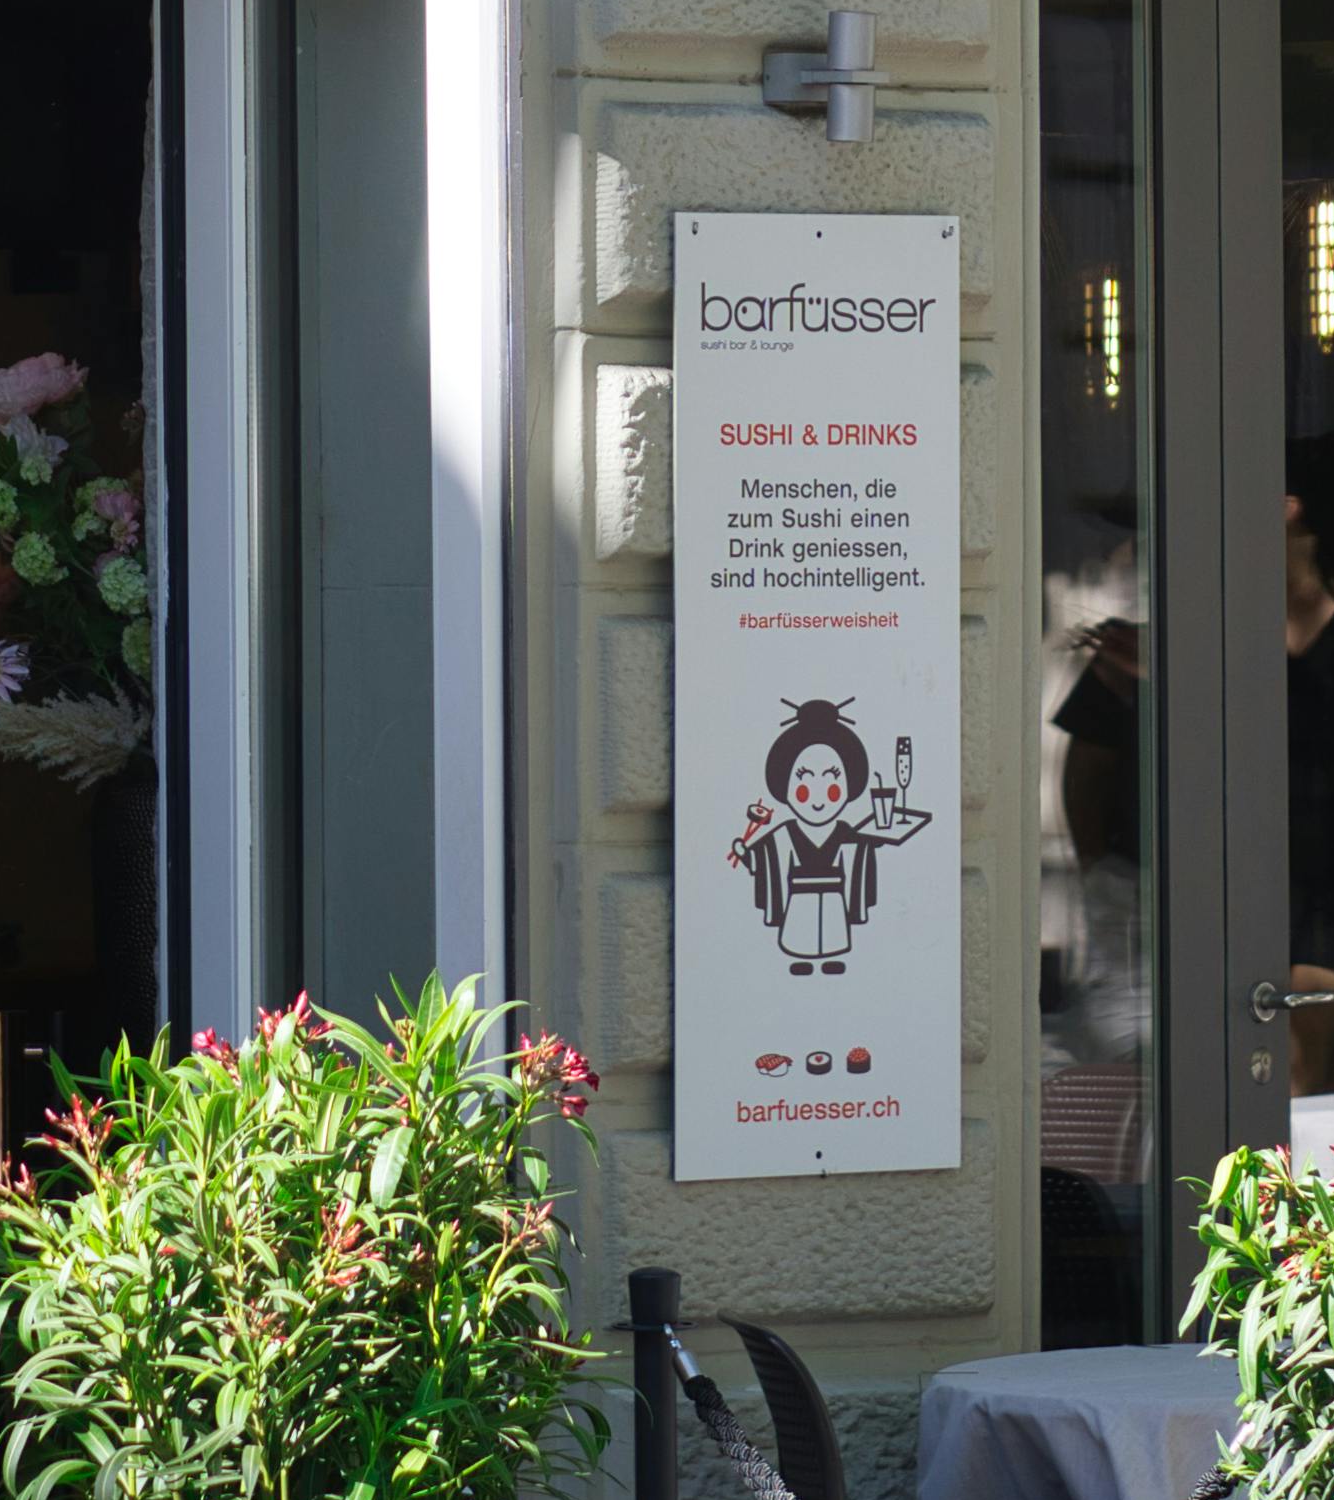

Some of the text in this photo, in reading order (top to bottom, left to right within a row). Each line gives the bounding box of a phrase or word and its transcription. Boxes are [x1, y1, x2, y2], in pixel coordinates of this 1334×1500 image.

[701, 282, 936, 333] barfüsser
[700, 340, 795, 353] sushi bar & lounge
[720, 423, 918, 446] SUSHI & DRINKS
[741, 478, 897, 502] Menschen, die
[727, 508, 910, 529] zum Sushi einen
[729, 538, 908, 563] Drink geniessen,
[710, 567, 926, 592] sind hochintelligent.
[738, 612, 899, 629] #barfüsserweisheit
[736, 1095, 901, 1123] barfuesser.ch
